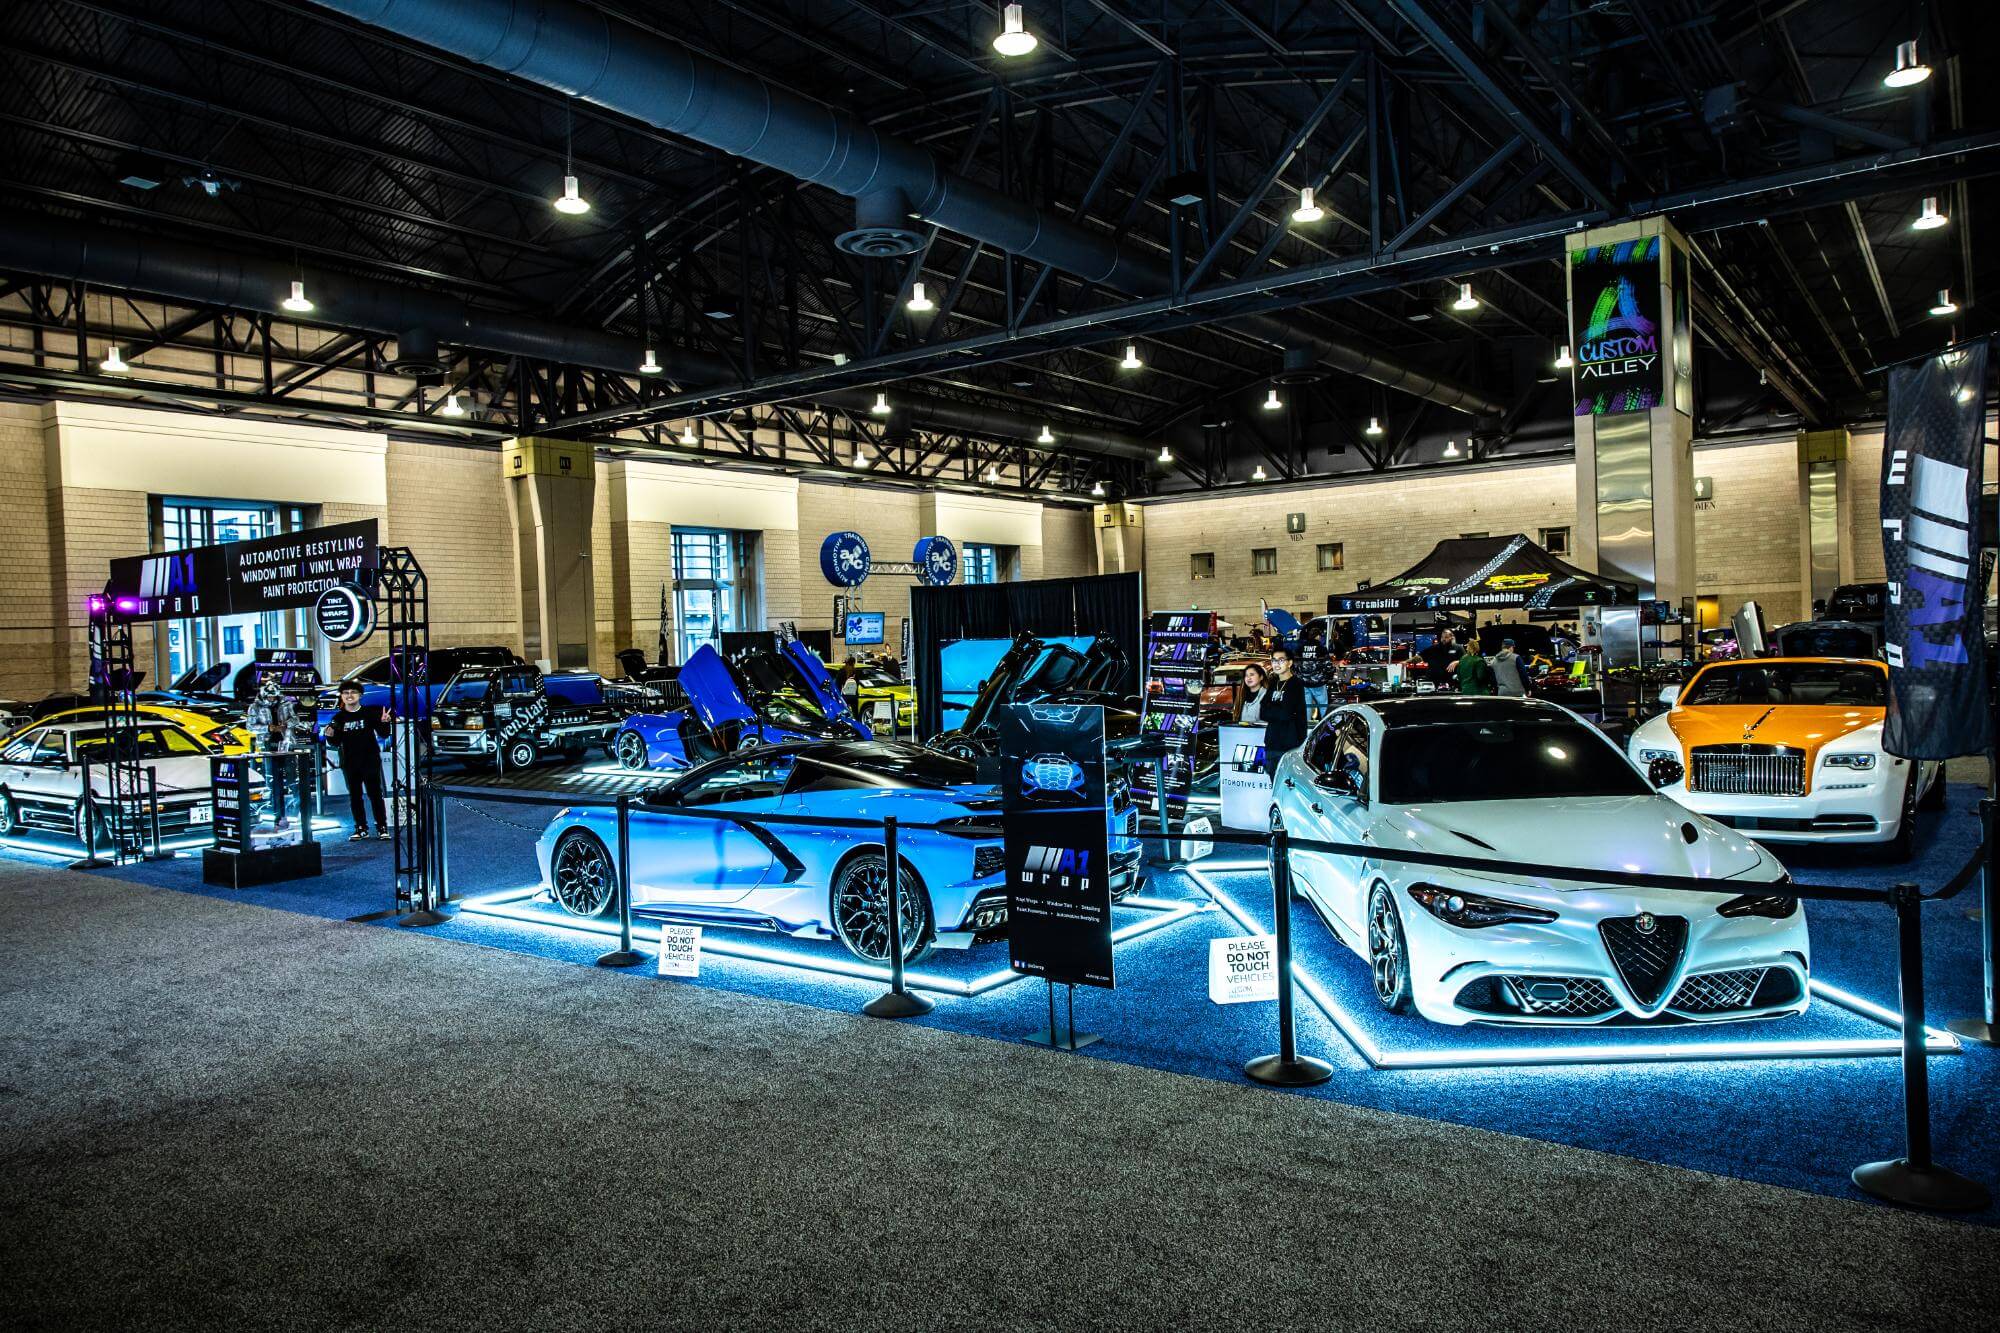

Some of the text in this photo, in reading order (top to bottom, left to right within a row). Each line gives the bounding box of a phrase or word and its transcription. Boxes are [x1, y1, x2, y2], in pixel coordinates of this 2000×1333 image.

[1580, 335, 1658, 362] CUSTOM
[1581, 356, 1656, 379] ALLEY
[240, 535, 364, 567] AUTOMOTIVE RESTYLING
[844, 532, 868, 553] TRAINING
[242, 555, 362, 583] WINDOW TINT VINYL WRAP
[832, 538, 848, 583] AUTOMOTIVE
[263, 577, 340, 598] PAINT PROTECTION
[139, 595, 199, 615] wrap
[1439, 592, 1524, 606] @raceplacehobbies
[1021, 871, 1090, 891] wrap
[668, 944, 692, 952] TOUCH
[1228, 940, 1266, 951] PLEASE
[664, 953, 694, 961] VEHICLES
[1226, 951, 1270, 963] DO NOT
[1229, 961, 1269, 972] TOUCH
[1226, 971, 1275, 984] VEHICLES
